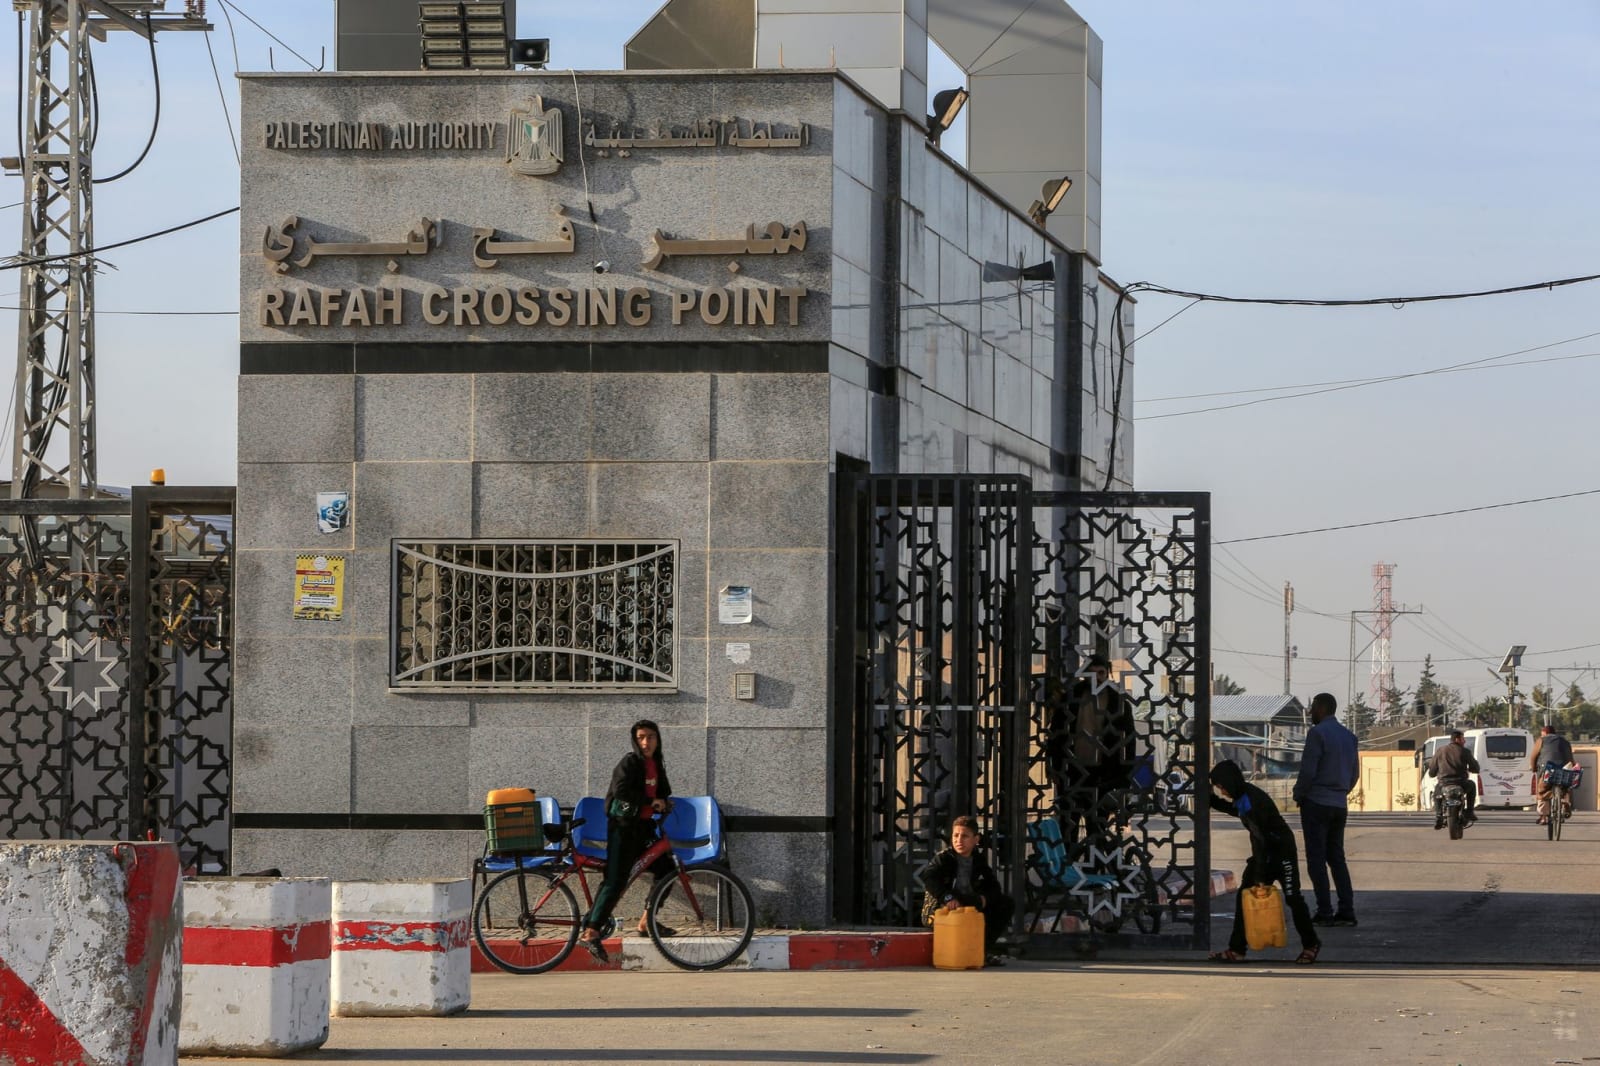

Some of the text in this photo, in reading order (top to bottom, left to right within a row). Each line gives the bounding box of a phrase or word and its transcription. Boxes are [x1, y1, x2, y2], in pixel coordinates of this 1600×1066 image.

[264, 121, 497, 150] PALESTINIAN AUTHORITY
[582, 113, 810, 158] السلطة الفلسطينية
[640, 220, 807, 273] معبر
[261, 287, 807, 326] RAFAH CROSSING POINT
